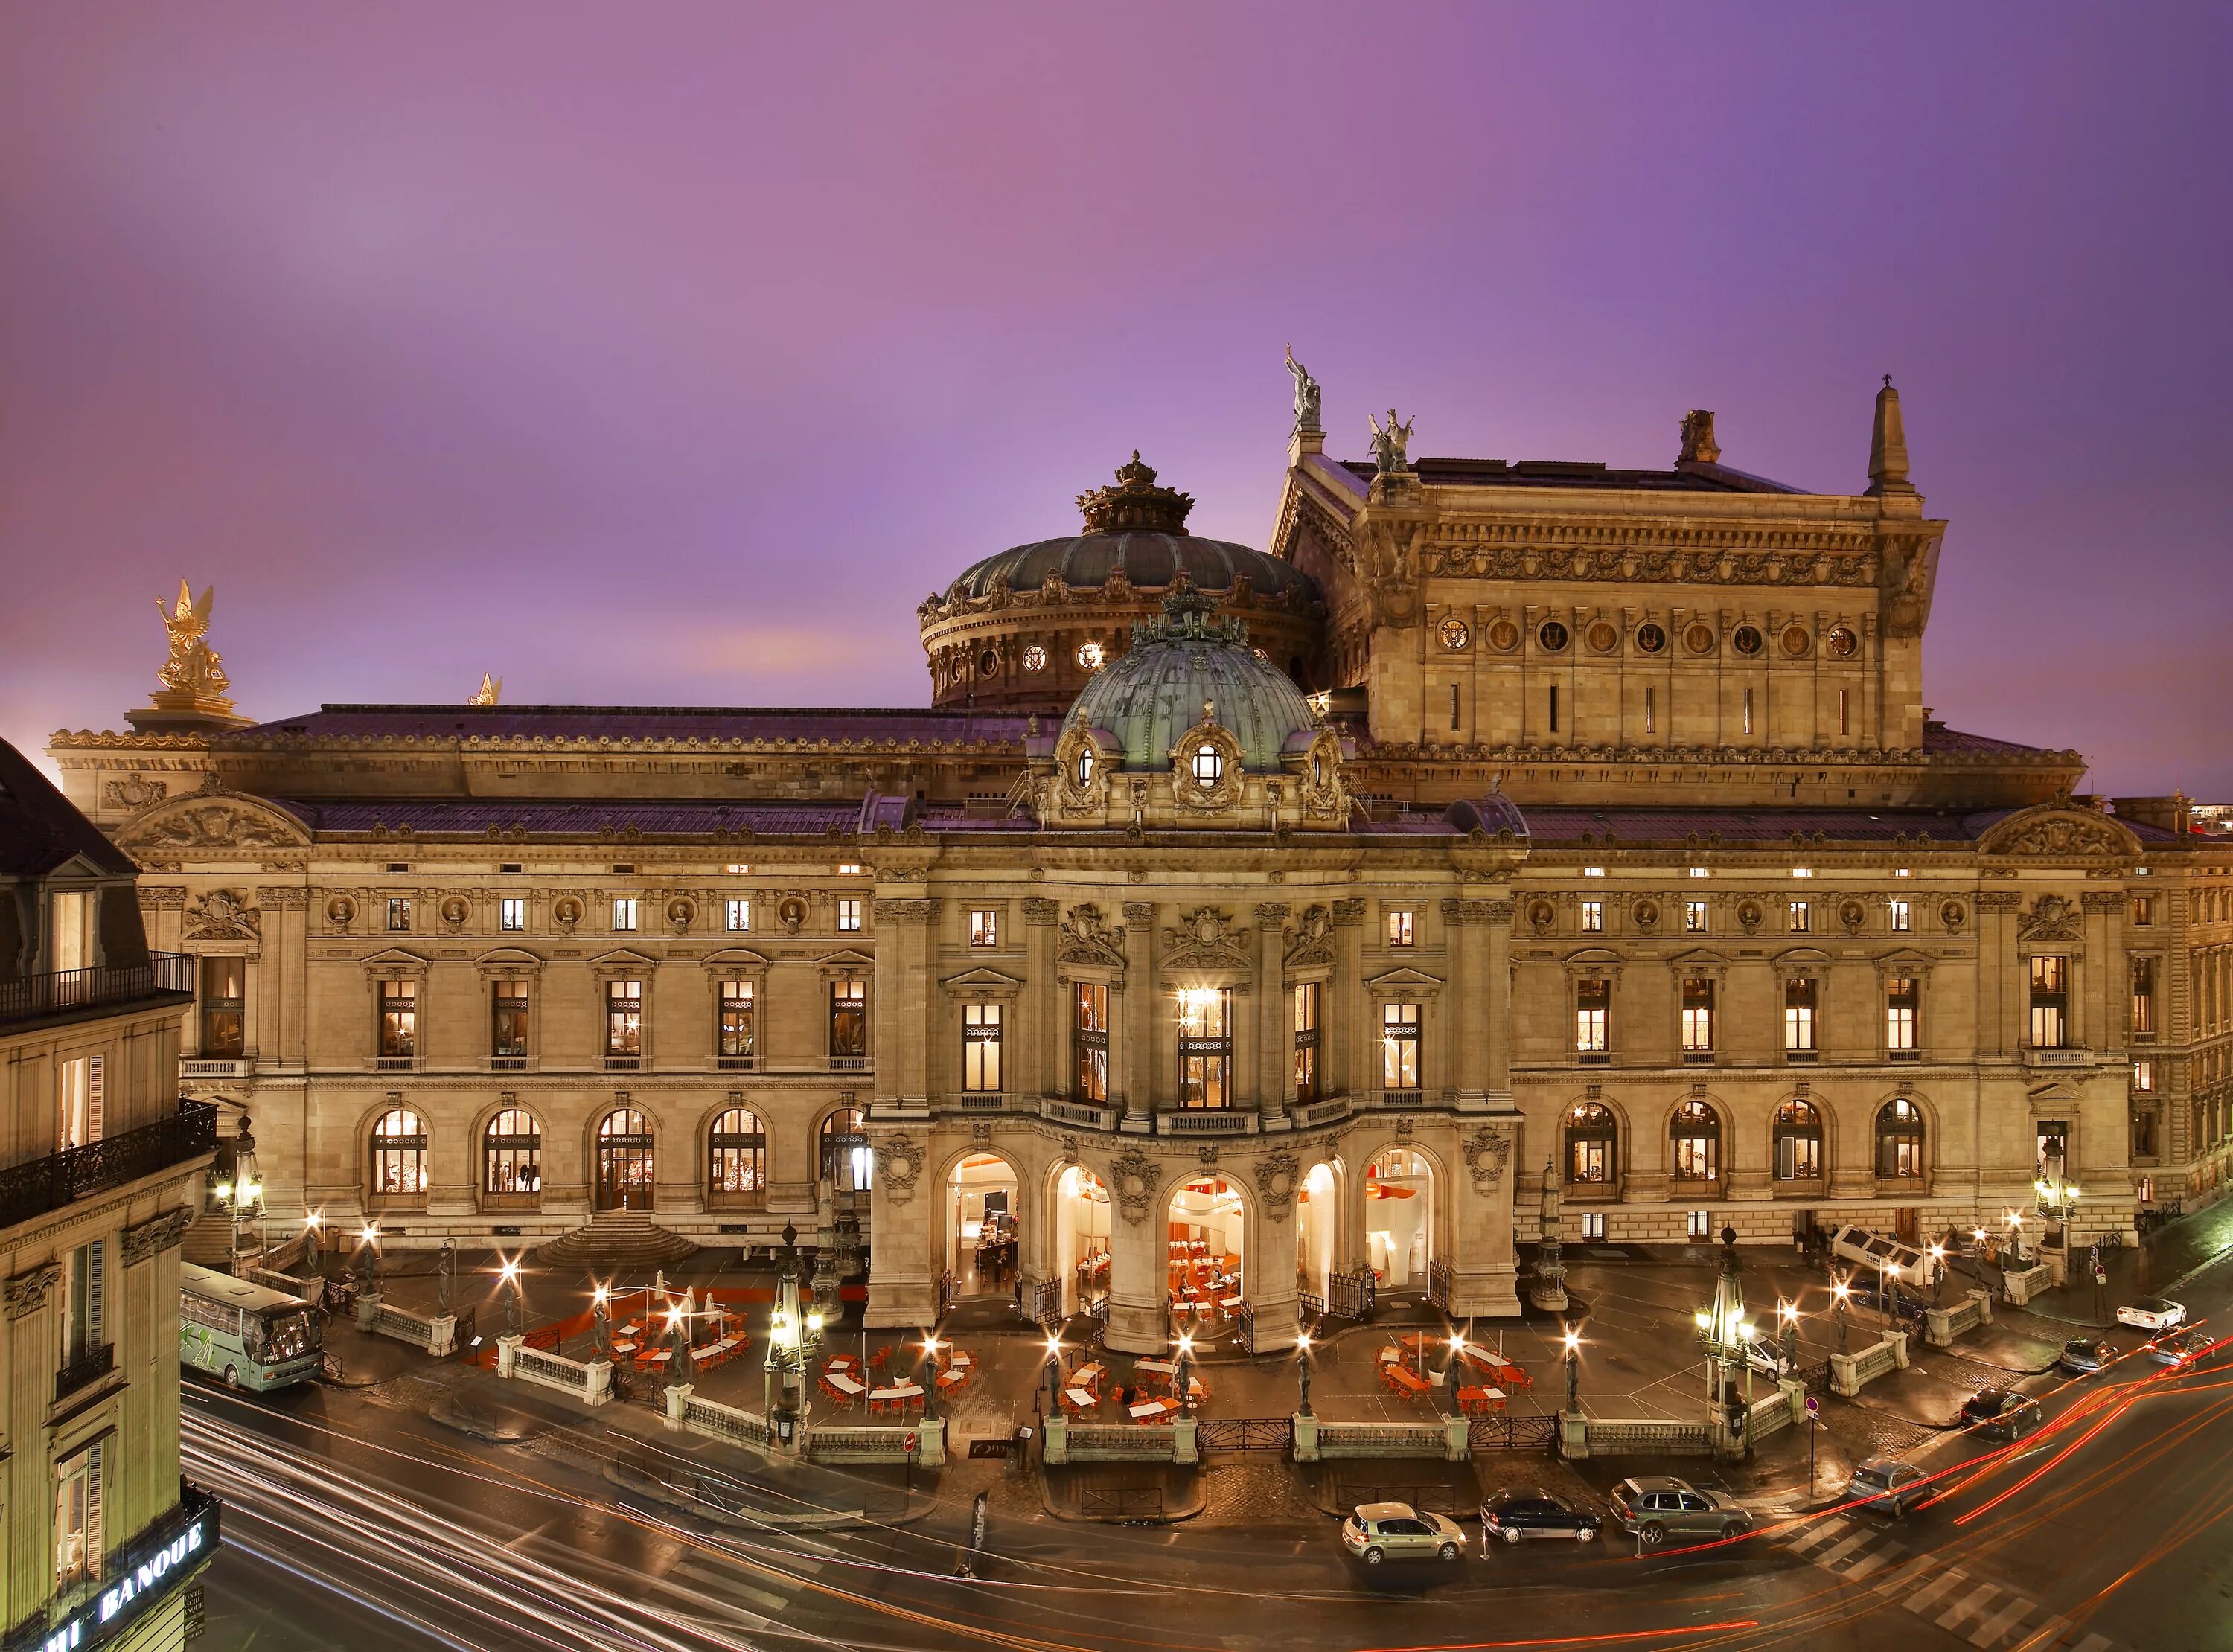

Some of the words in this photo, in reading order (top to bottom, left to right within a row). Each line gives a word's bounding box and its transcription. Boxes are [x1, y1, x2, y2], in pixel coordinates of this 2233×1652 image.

[974, 1498, 986, 1550] voiturier
[36, 1618, 80, 1652] HI
[100, 1522, 202, 1624] BANQUE
